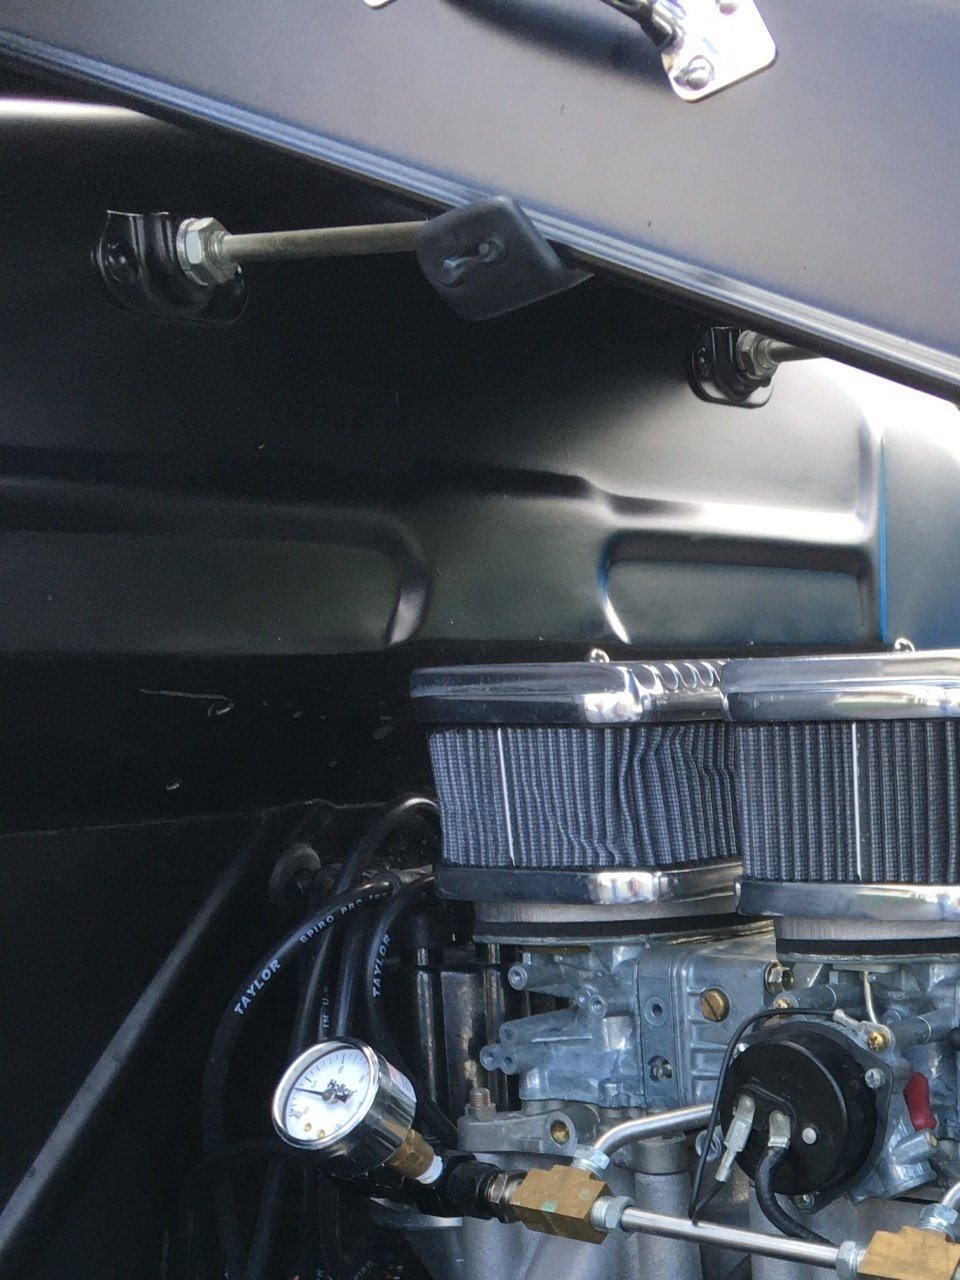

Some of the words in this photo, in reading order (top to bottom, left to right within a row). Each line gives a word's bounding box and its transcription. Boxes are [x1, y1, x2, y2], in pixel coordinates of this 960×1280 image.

[234, 959, 281, 1015] TAYLOR
[300, 915, 334, 943] SPIRO
[373, 934, 391, 998] TAYLOR
